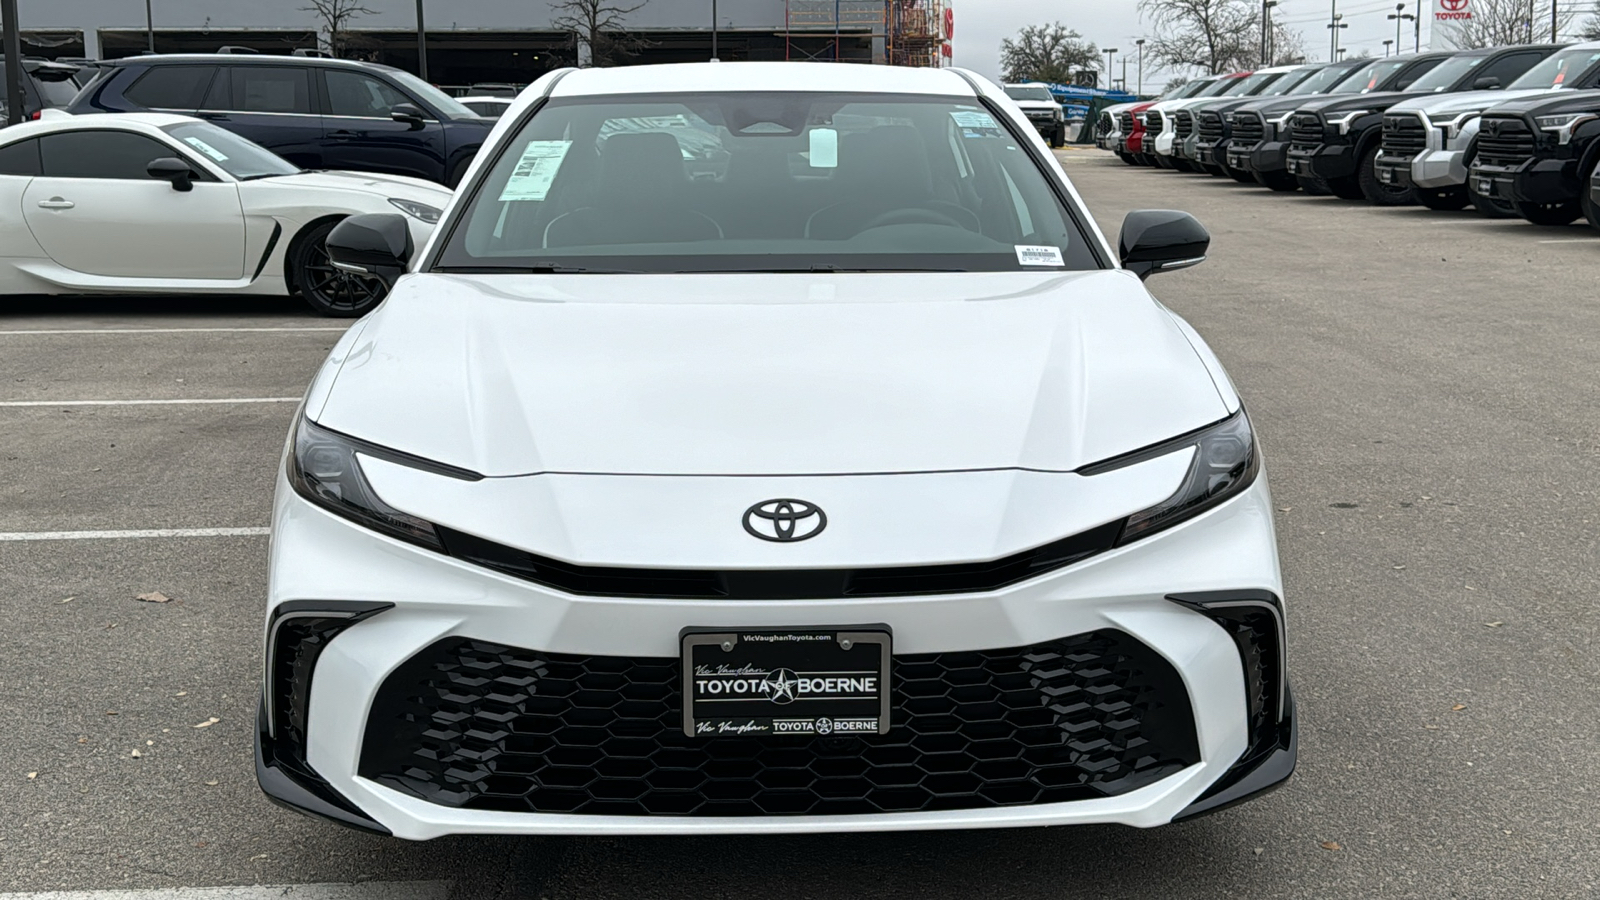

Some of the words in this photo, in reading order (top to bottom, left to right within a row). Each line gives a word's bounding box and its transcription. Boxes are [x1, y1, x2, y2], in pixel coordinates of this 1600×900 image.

[1435, 12, 1472, 20] TOYOTA
[743, 634, 832, 643] VicVaughanToyota.com
[695, 664, 713, 676] Vic
[716, 662, 766, 676] Vaughan
[696, 679, 770, 694] TOYOTA
[798, 678, 877, 693] BOERNE
[696, 721, 715, 734] Vic
[718, 720, 769, 735] Vaughan
[773, 722, 814, 731] TOYOTA
[834, 721, 878, 730] BOERNE
